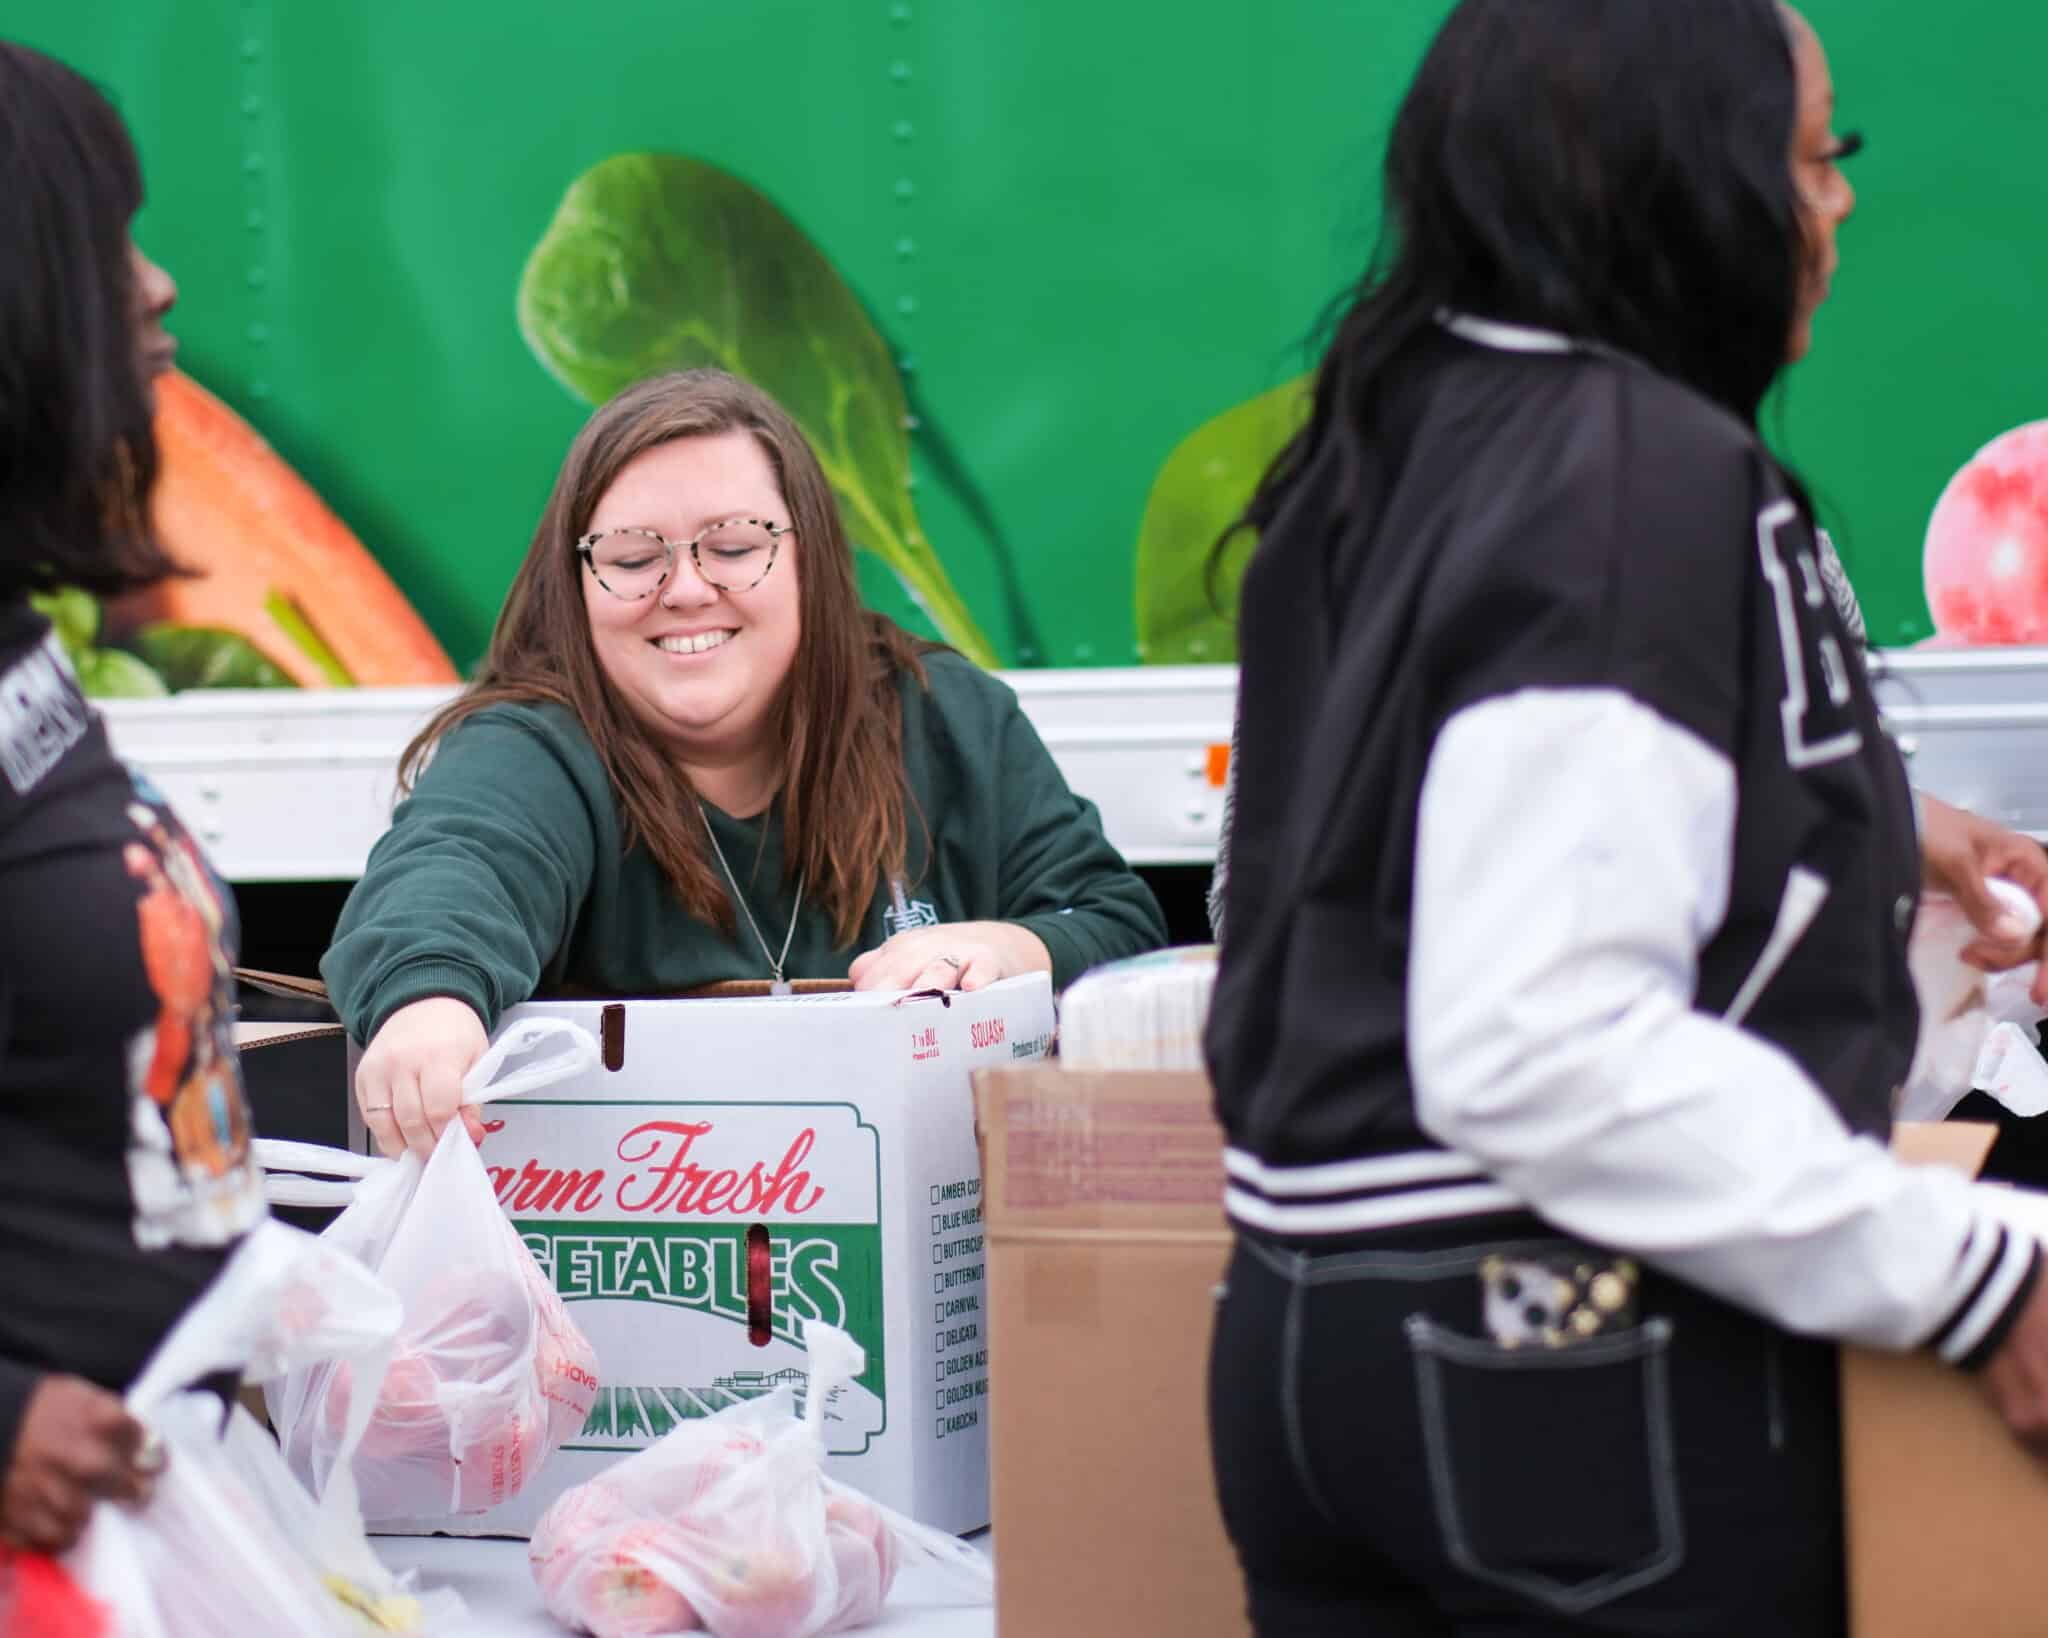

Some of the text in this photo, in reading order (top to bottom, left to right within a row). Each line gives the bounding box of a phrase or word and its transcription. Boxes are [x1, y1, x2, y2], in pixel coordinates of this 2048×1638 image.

[971, 1017, 1005, 1048] SQUASH
[478, 1119, 824, 1215] arm Fresh
[941, 1182, 966, 1201] AMBER
[942, 1211, 960, 1231] BLUE
[943, 1235, 984, 1259] BUTTERCUP
[945, 1263, 985, 1289] BUTTERNUT
[945, 1295, 980, 1318] CARNIVAL
[946, 1323, 978, 1346] DELICATA
[554, 1357, 598, 1393] Have
[946, 1353, 974, 1375] GOLDEN
[946, 1382, 974, 1406] GOLDEN
[946, 1408, 978, 1434] KABOCHA
